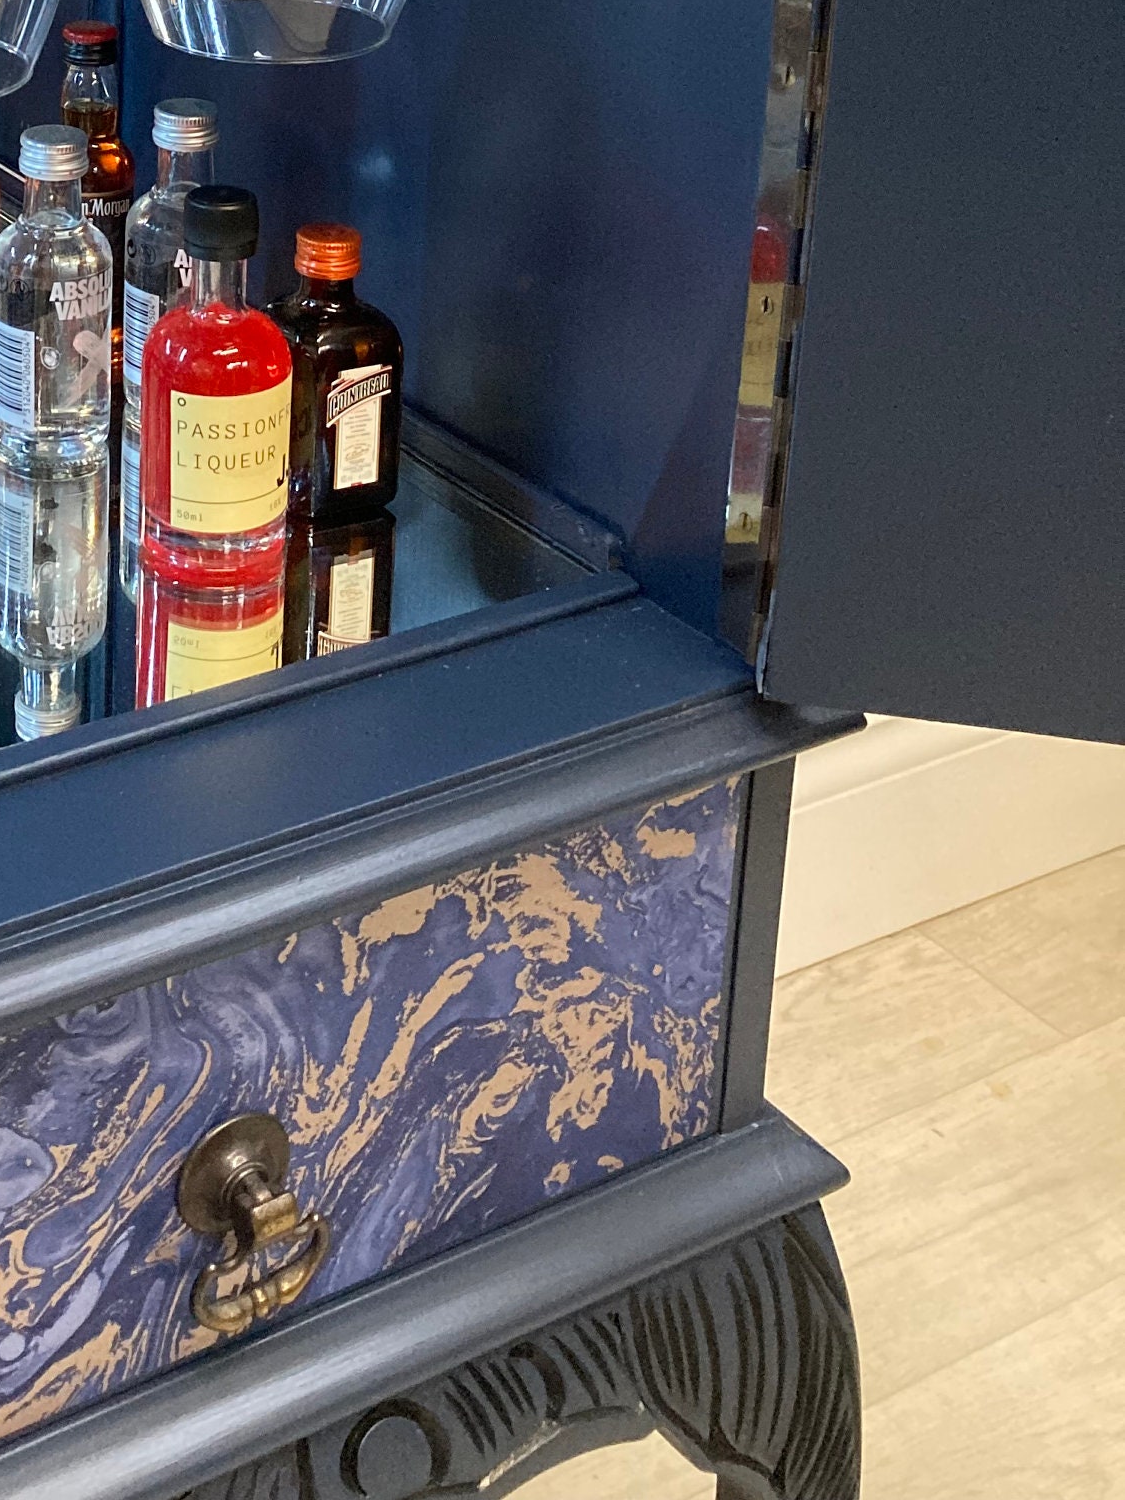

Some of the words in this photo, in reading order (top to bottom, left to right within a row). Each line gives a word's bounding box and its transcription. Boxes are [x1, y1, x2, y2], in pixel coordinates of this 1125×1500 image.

[328, 372, 391, 422] COINTREAU
[177, 444, 276, 475] LIQUEUR
[176, 508, 203, 523] 50ml
